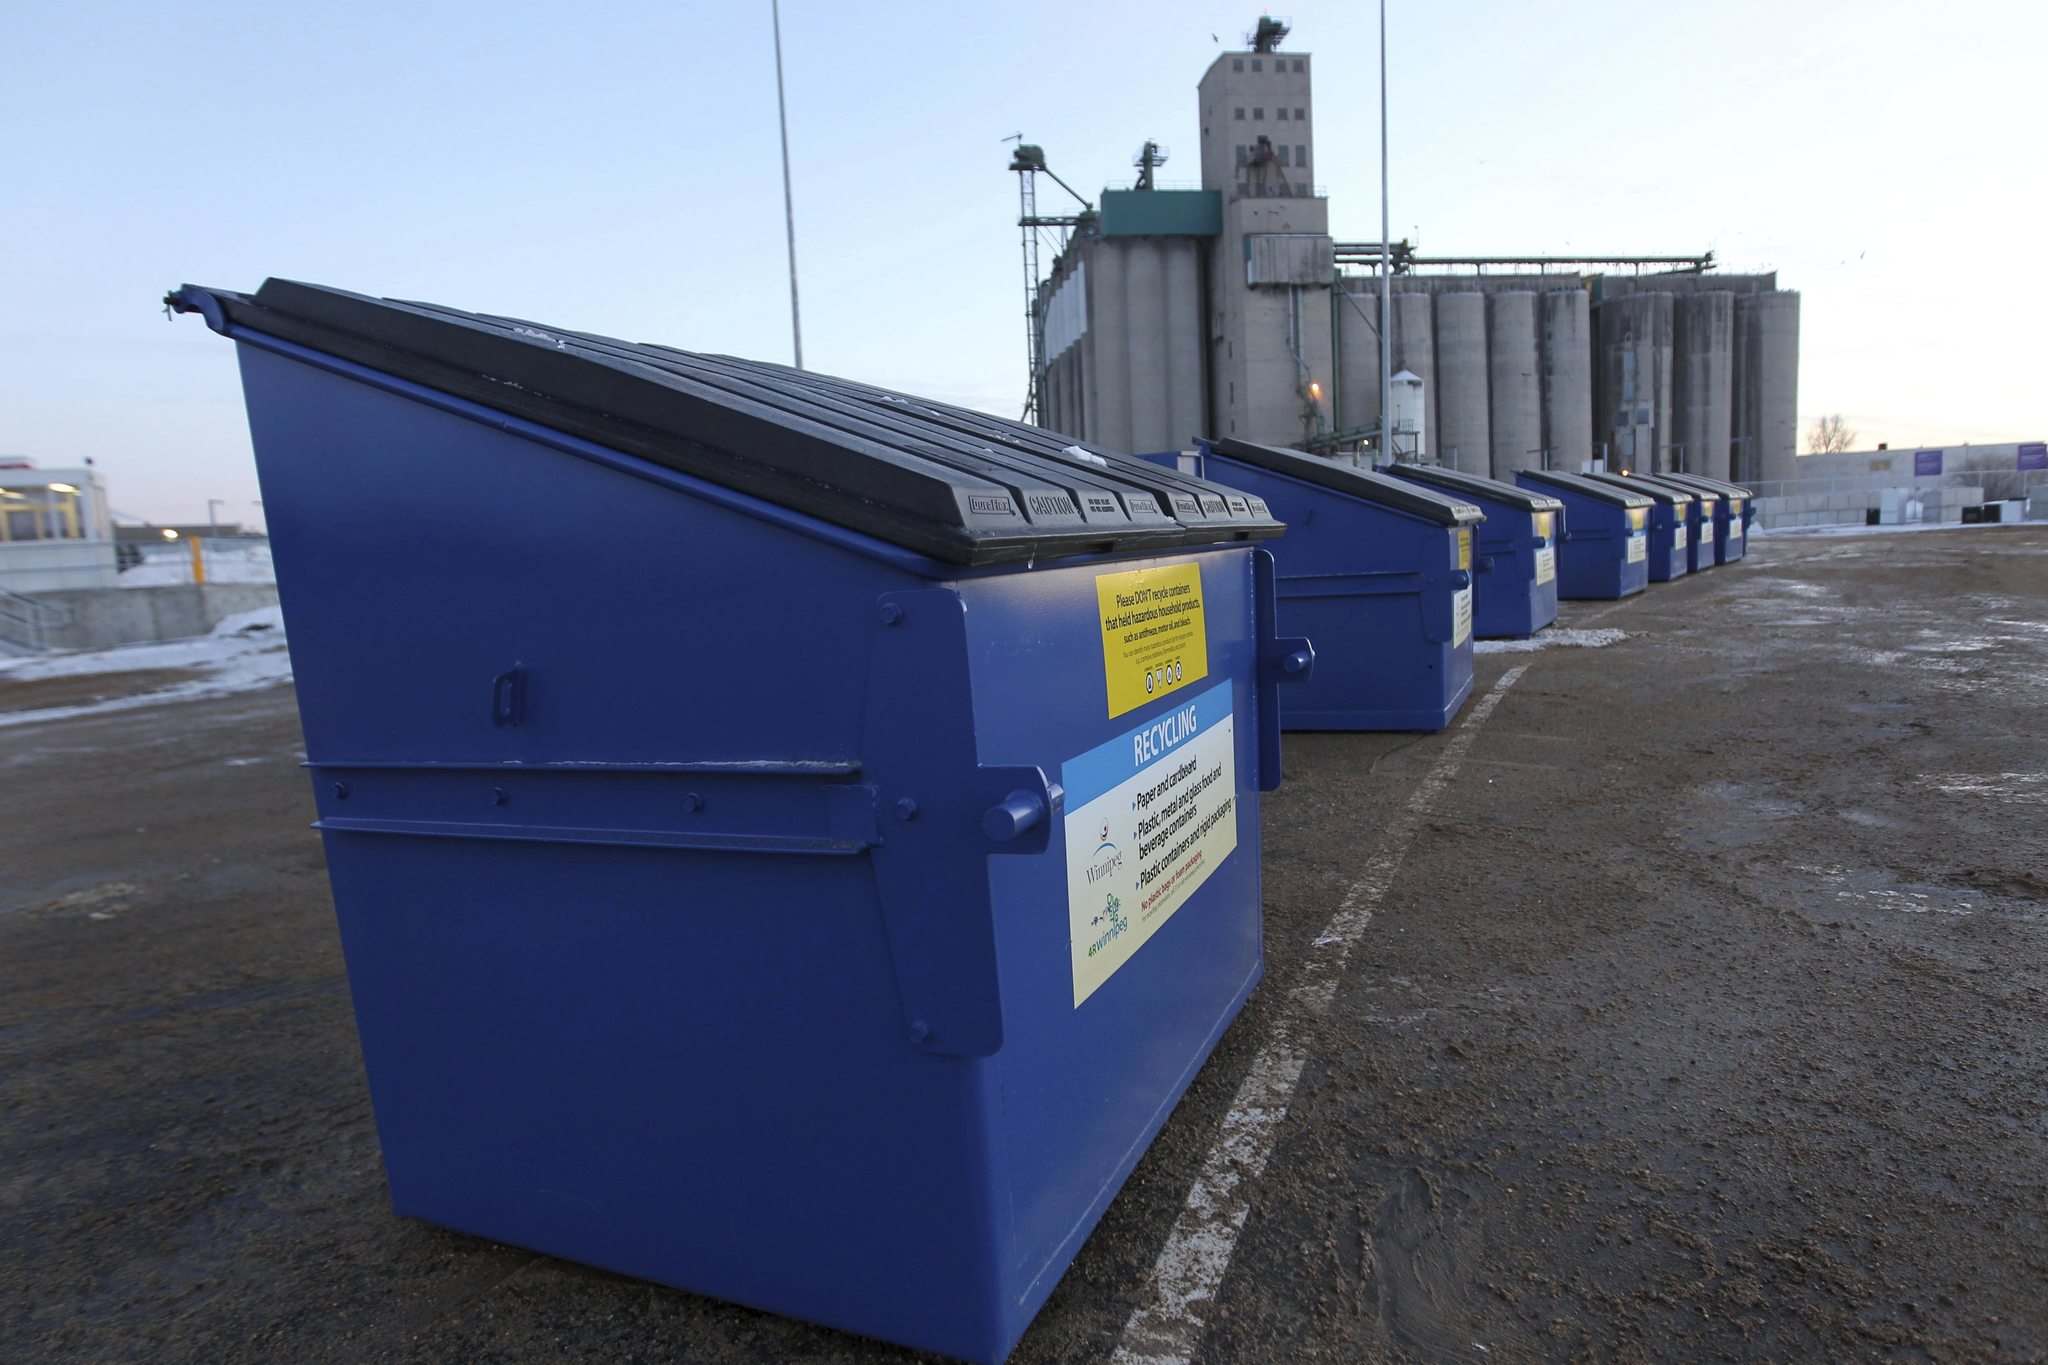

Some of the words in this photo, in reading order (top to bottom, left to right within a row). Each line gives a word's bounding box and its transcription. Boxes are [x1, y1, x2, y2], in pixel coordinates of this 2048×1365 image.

[1029, 496, 1075, 514] CAUTION
[1105, 616, 1118, 631] that
[1118, 611, 1131, 628] held
[1131, 608, 1158, 624] hazardous
[1158, 600, 1181, 617] household
[1116, 593, 1134, 608] Please
[1152, 586, 1168, 602] recycle
[1168, 583, 1190, 597] containers
[1134, 705, 1197, 766] RECYCLING
[1137, 786, 1156, 811] Paper
[1157, 773, 1168, 797] and
[1169, 754, 1196, 788] cardboard
[1161, 795, 1178, 821] metal
[1178, 787, 1189, 808] and
[1189, 781, 1201, 804] glass
[1202, 768, 1212, 790] food
[1213, 760, 1221, 781] and
[1139, 827, 1168, 861] beverage
[1168, 804, 1197, 836] containers
[1140, 859, 1161, 889] Plastic
[1161, 838, 1189, 870] containers
[1189, 823, 1199, 844] and
[1200, 814, 1210, 838] rigid
[1210, 797, 1231, 828] packaging
[1086, 850, 1123, 886] Winnipeg
[1141, 897, 1148, 912] No
